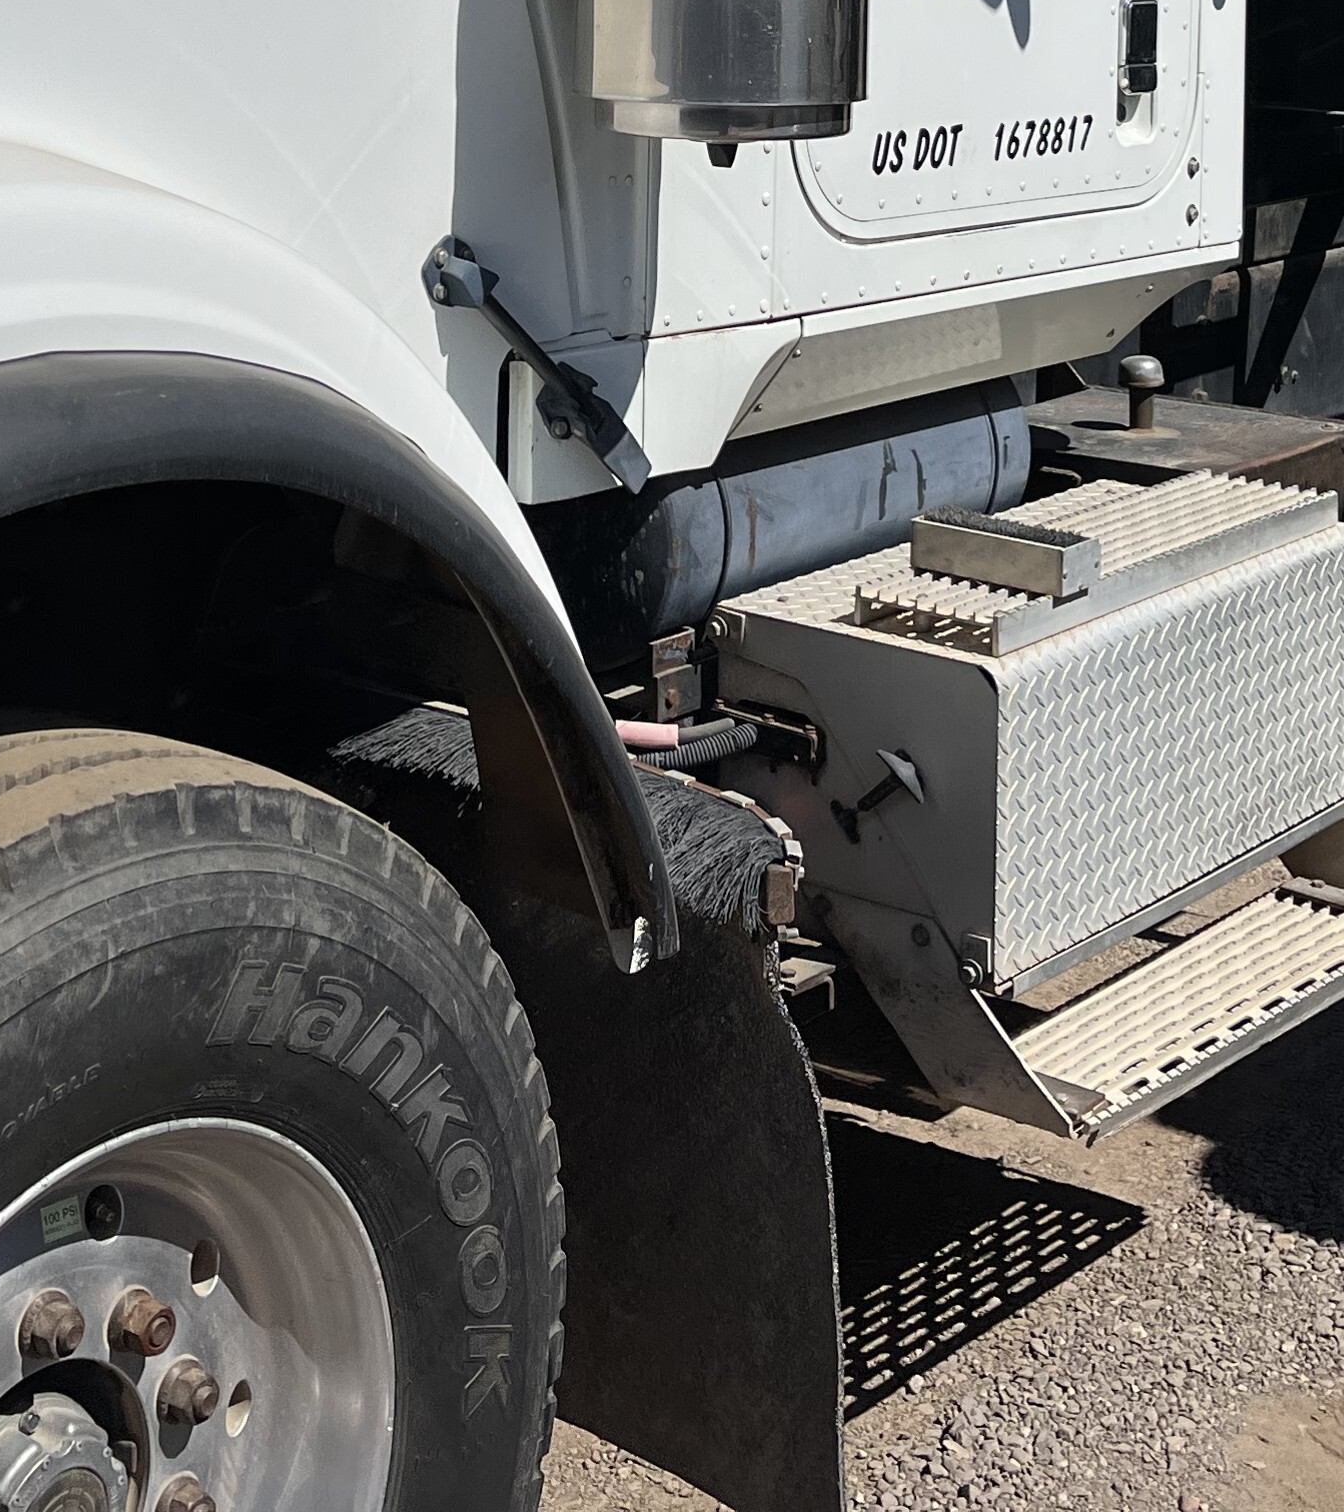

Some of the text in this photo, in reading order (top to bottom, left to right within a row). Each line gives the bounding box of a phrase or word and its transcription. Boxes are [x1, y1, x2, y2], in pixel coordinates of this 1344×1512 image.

[872, 114, 1094, 175] US DOT 1678817
[43, 1203, 78, 1225] 100 PSI
